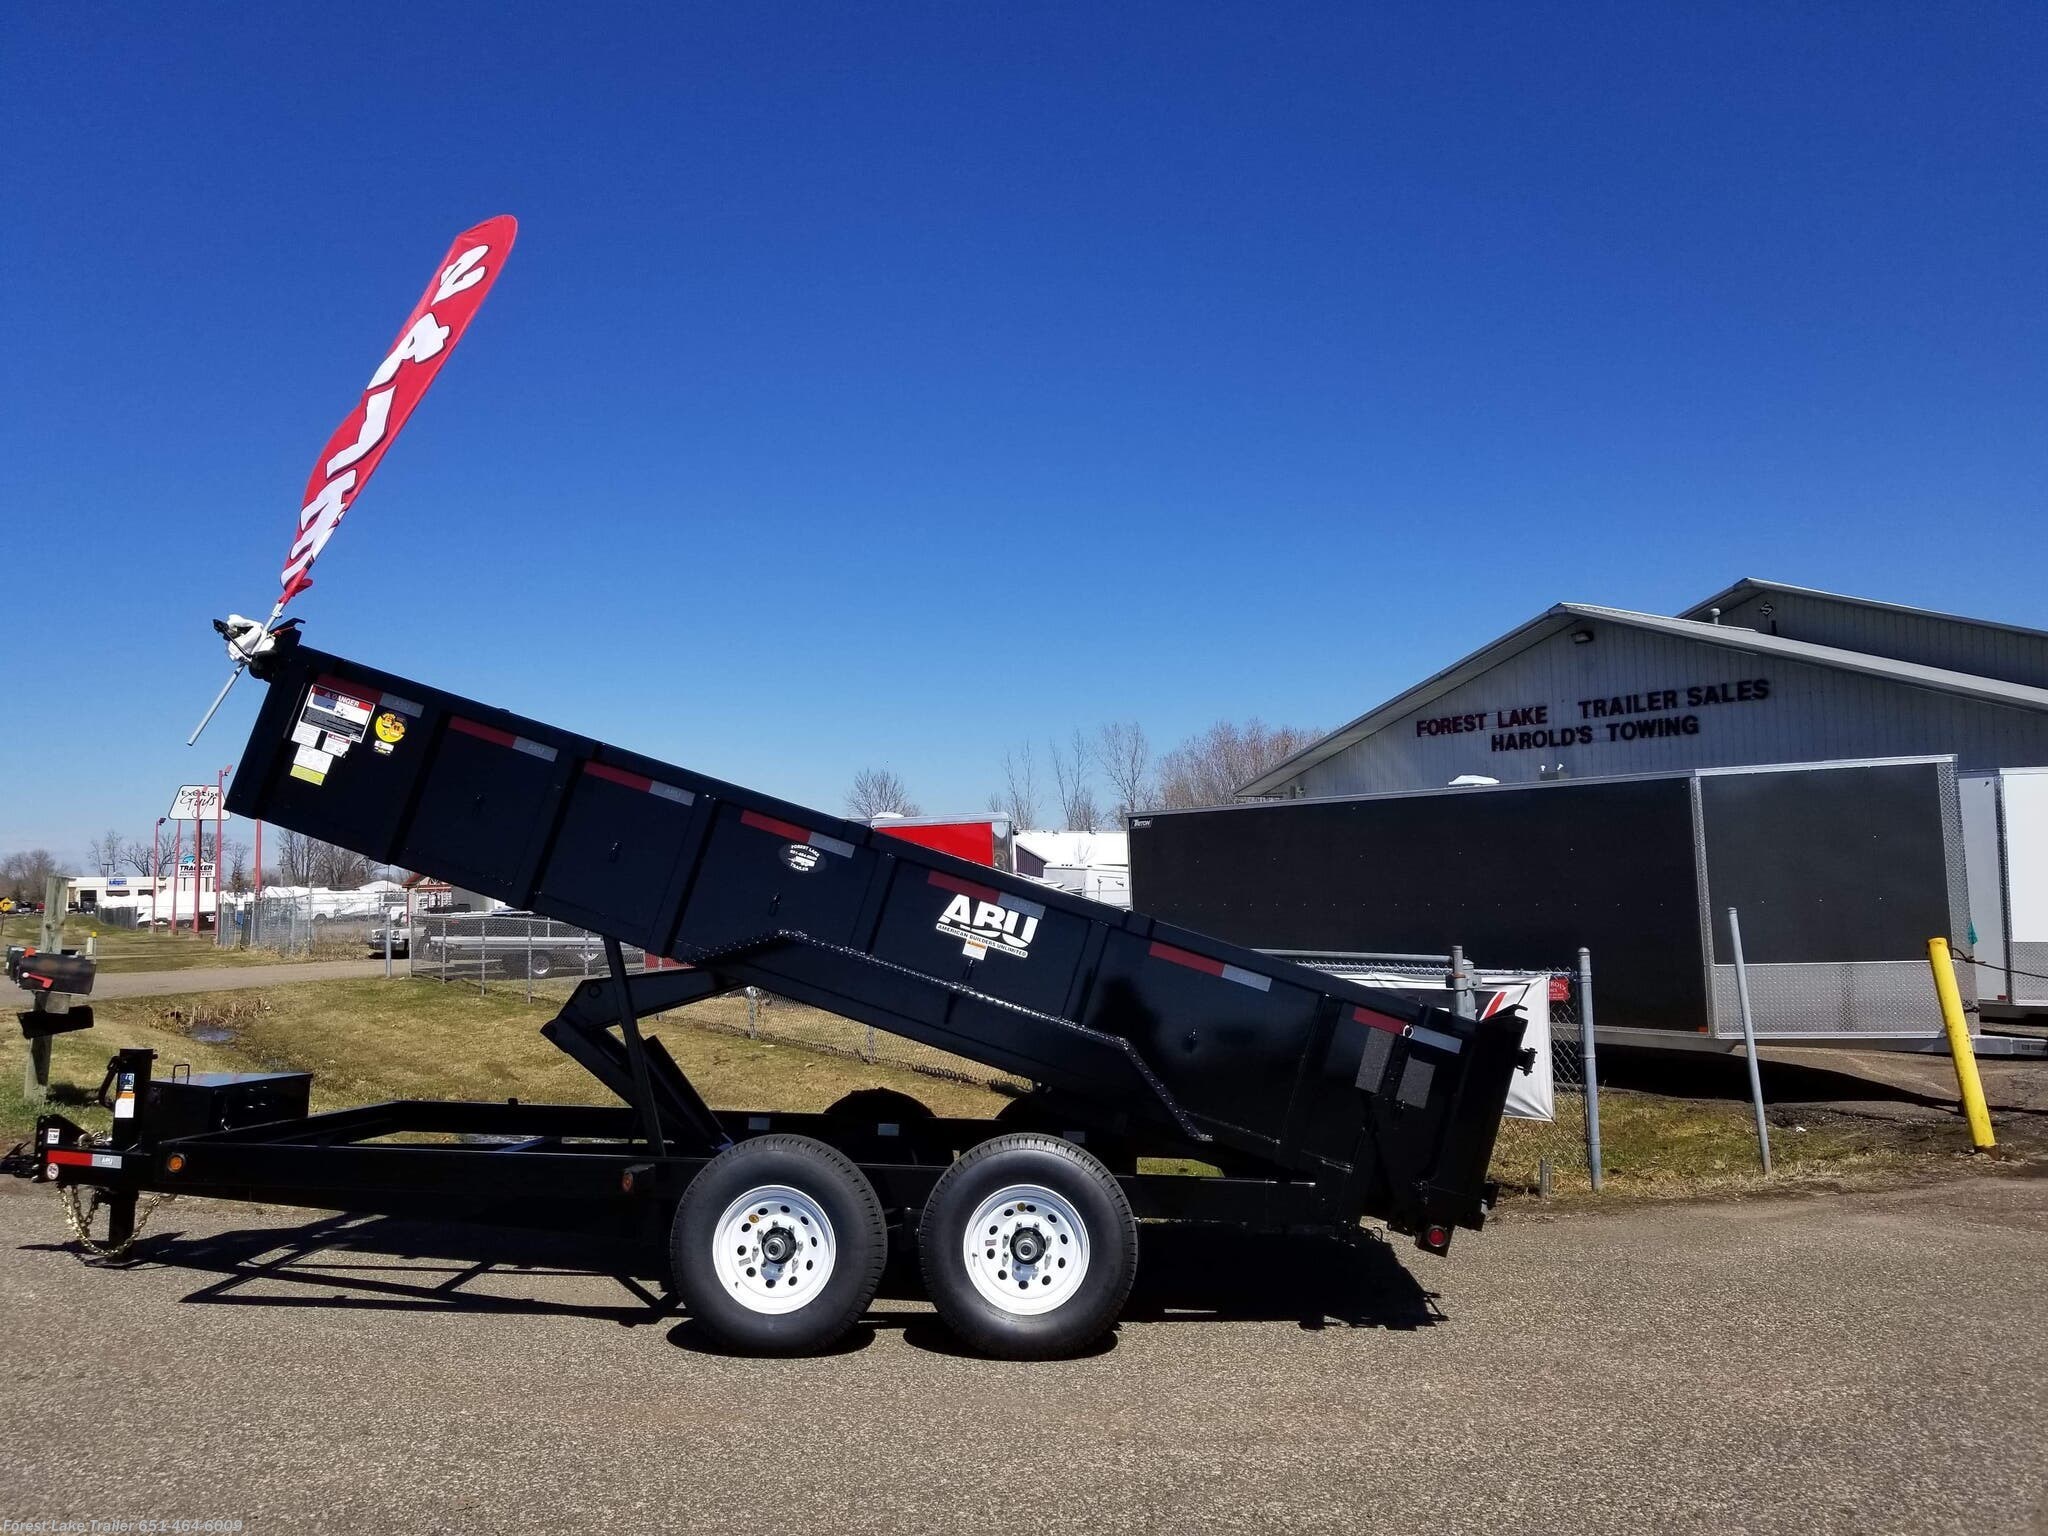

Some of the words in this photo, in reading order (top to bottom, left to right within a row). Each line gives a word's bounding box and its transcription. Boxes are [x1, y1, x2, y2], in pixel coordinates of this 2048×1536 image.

[1416, 712, 1488, 738] FOREST
[1497, 705, 1548, 729] LAKE
[1577, 689, 1679, 719] TRAILER
[1687, 678, 1770, 707] SALES
[1490, 725, 1593, 752] HAROLD'S
[1605, 714, 1699, 742] TOWING
[937, 925, 969, 939] AMERICAN
[969, 934, 996, 948] BUILDERS
[996, 943, 1027, 957] UNLIMITED
[938, 893, 1039, 948] ABU
